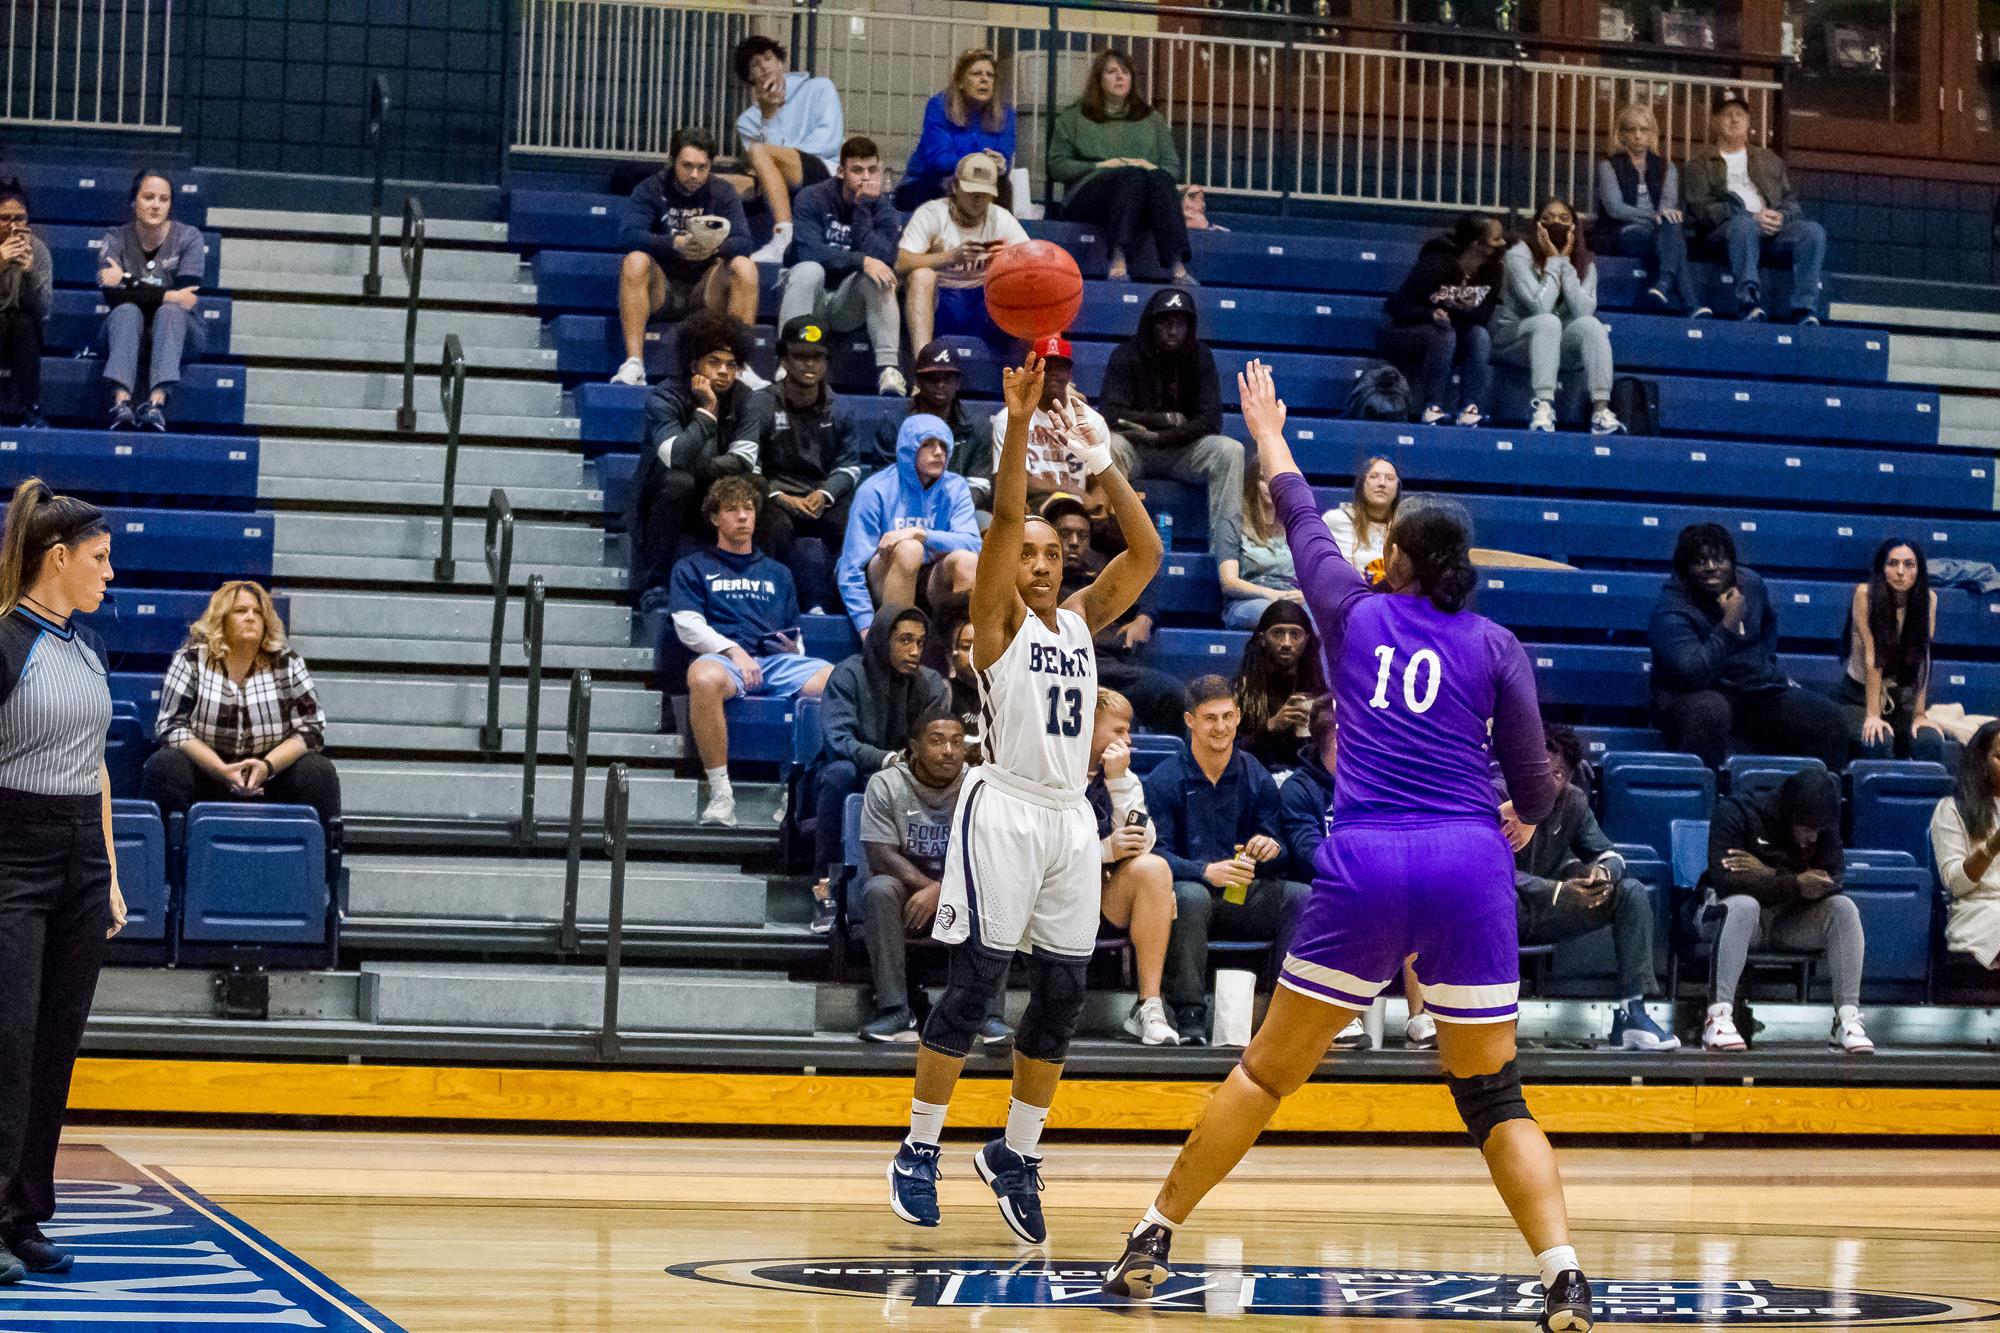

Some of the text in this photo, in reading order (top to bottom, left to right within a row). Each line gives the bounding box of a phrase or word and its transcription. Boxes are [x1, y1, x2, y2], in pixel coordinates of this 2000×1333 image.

[712, 578, 761, 592] BERRY
[1369, 645, 1441, 713] 10
[1045, 684, 1083, 738] 13
[906, 822, 952, 841] FOUR
[803, 1267, 1215, 1279] AOCIATION
[1453, 1306, 1862, 1315] SOUTHRN
